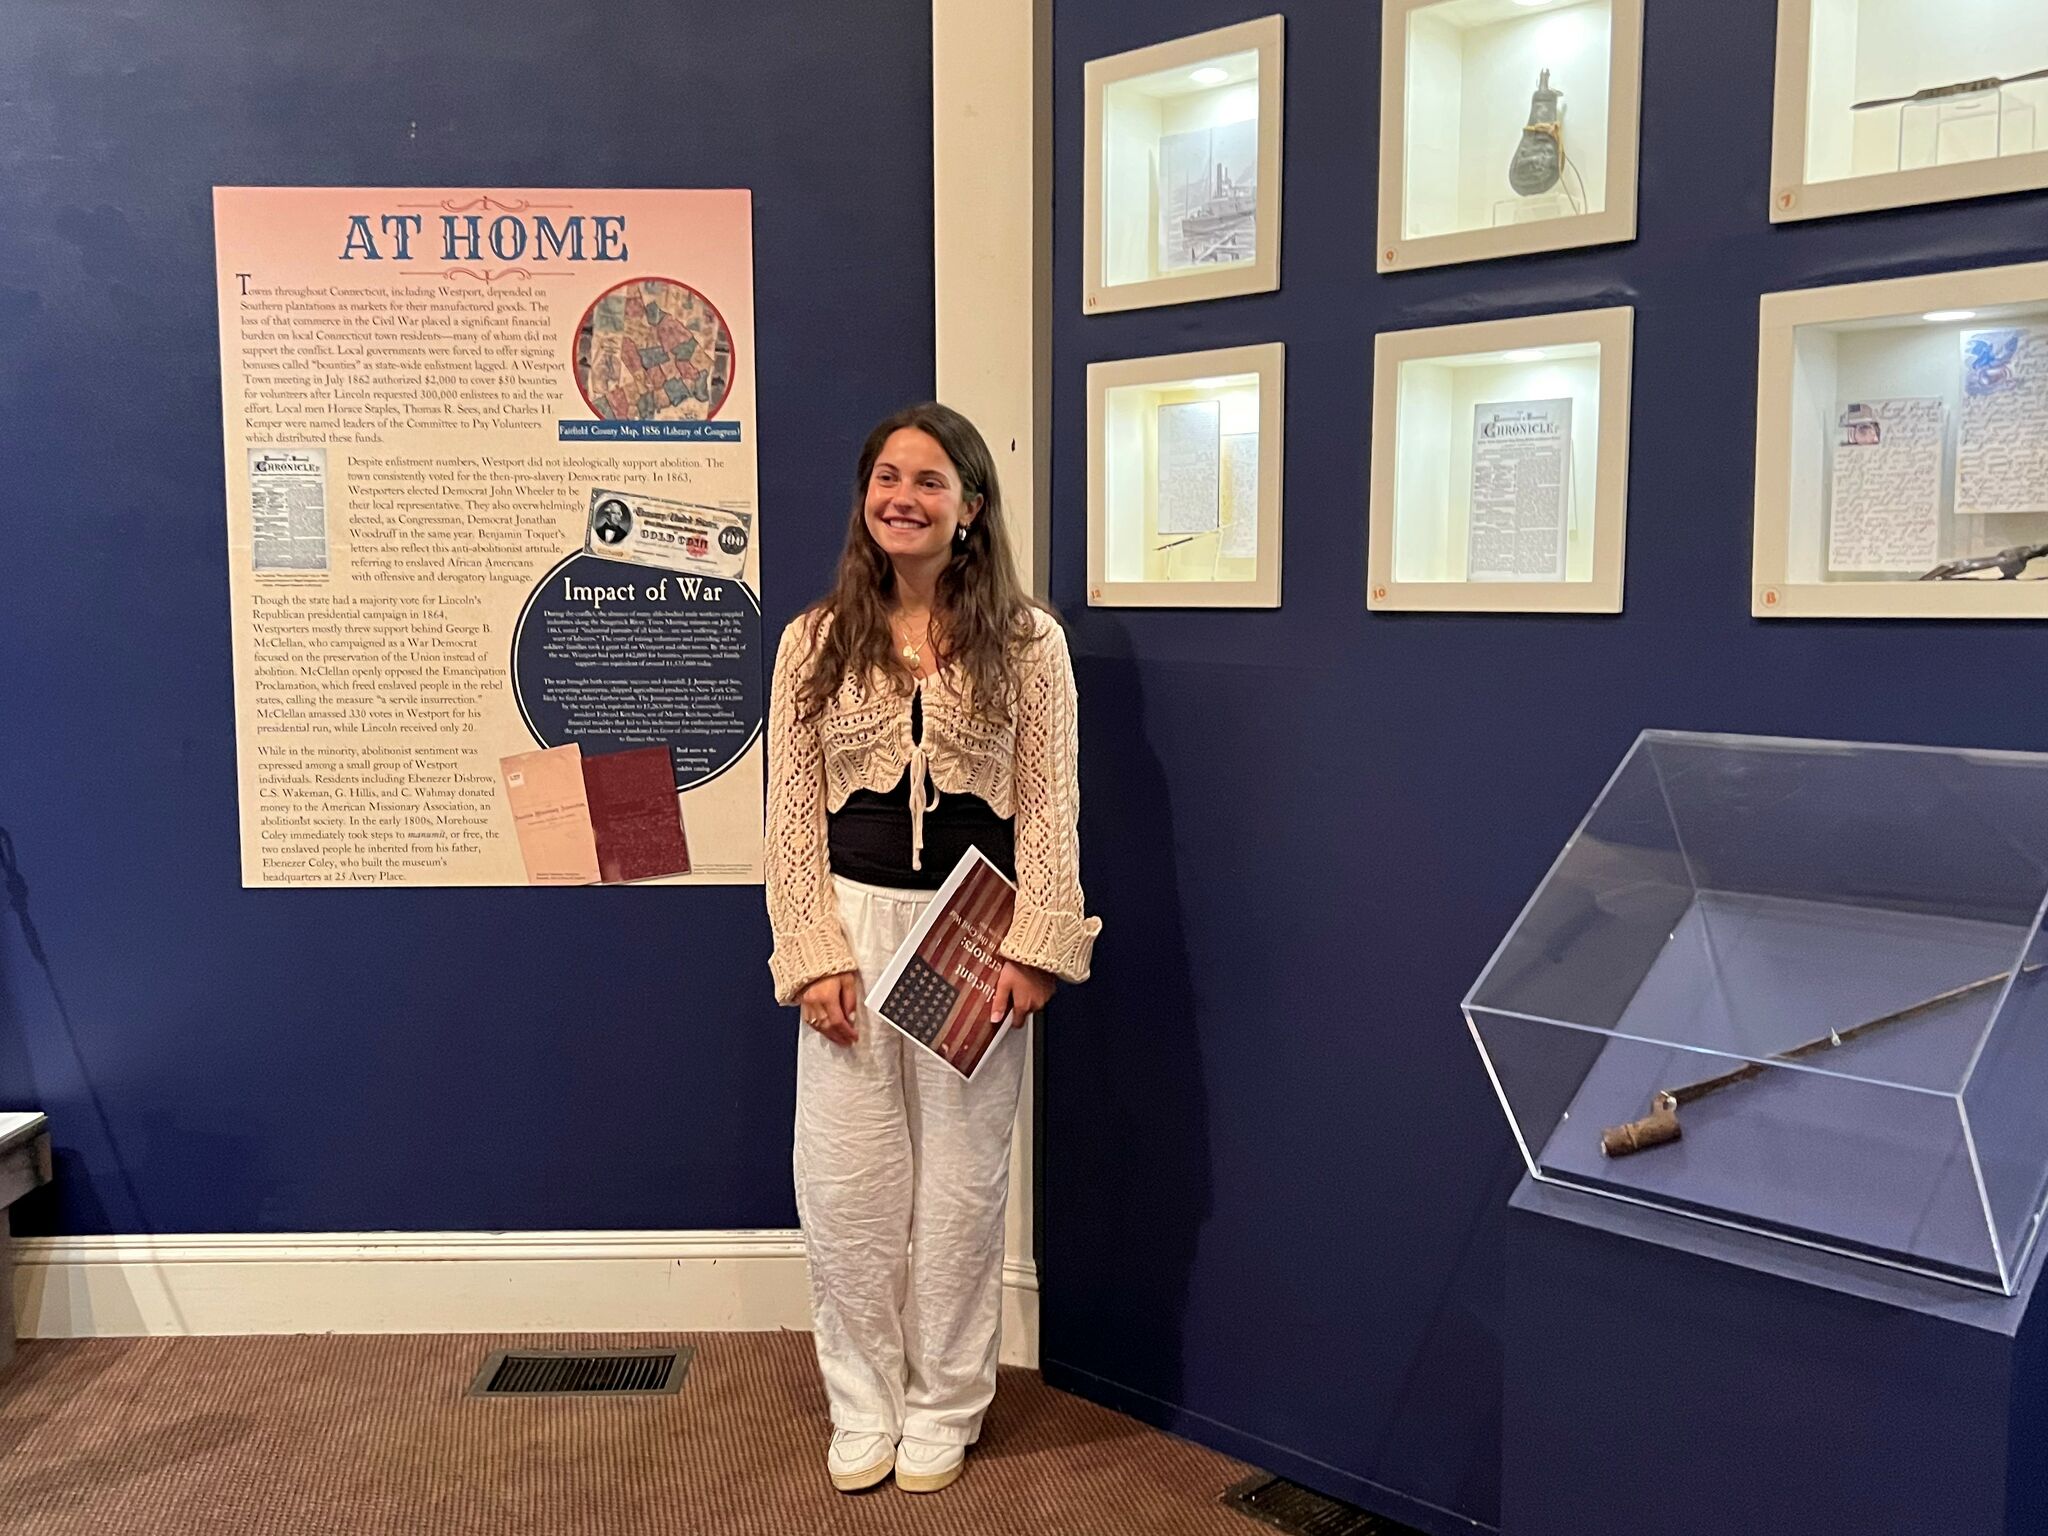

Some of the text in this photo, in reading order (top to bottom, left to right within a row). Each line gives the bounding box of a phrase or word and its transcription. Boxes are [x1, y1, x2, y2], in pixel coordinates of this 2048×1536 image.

[338, 214, 629, 262] AT HOME
[236, 273, 272, 296] Towns
[275, 287, 327, 299] throughout
[330, 287, 388, 298] Connecticut,
[392, 287, 435, 299] including
[438, 287, 484, 299] Westport,
[487, 287, 532, 299] depended
[240, 302, 282, 311] Southern
[286, 302, 335, 313] plantations
[350, 302, 387, 311] markets
[390, 302, 402, 311] for
[406, 302, 426, 311] their
[430, 302, 494, 311] manufactured
[530, 302, 548, 311] The
[241, 316, 258, 326] loss
[261, 316, 270, 326] of
[273, 316, 290, 326] that
[343, 317, 352, 326] in
[355, 316, 369, 326] the
[372, 316, 395, 326] Civil
[398, 316, 418, 326] War
[421, 316, 451, 328] placed
[461, 316, 508, 328] significant
[512, 316, 550, 326] financial
[246, 375, 271, 385] Town
[274, 376, 311, 387] meeting
[314, 376, 322, 385] in
[325, 375, 343, 387] July
[348, 375, 370, 385] 1862
[373, 375, 422, 385] authorized
[425, 375, 456, 387] $2,000
[459, 376, 468, 385] to
[518, 375, 556, 385] bounties
[244, 390, 257, 399] for
[260, 390, 308, 399] volunteers
[310, 390, 330, 399] after
[334, 390, 370, 399] Lincoln
[374, 390, 417, 401] requested
[421, 390, 458, 401] 300,000
[501, 391, 510, 399] to
[513, 390, 527, 399] aid
[530, 390, 543, 399] the
[560, 425, 588, 435] Fairfield
[590, 425, 618, 437] County
[694, 426, 702, 435] of
[246, 433, 273, 443] which
[276, 433, 326, 443] distributed
[329, 433, 352, 443] these
[348, 457, 383, 469] Despite
[385, 457, 432, 467] enlistment
[436, 457, 479, 468] numbers,
[482, 457, 524, 469] Westport
[528, 457, 543, 467] did
[546, 458, 560, 467] not
[563, 457, 620, 469] ideologically
[623, 458, 657, 469] support
[705, 457, 724, 467] The
[348, 472, 370, 481] town
[373, 472, 425, 483] consistently
[429, 472, 454, 481] voted
[457, 472, 470, 481] for
[473, 472, 486, 481] the
[568, 472, 620, 481] Democratic
[653, 472, 663, 481] In
[667, 472, 691, 482] 1863,
[398, 515, 464, 526] Congressman,
[467, 515, 512, 524] Democrat
[515, 515, 556, 526] Jonathan
[564, 576, 725, 607] Impact of War
[1374, 588, 1386, 600] 10
[252, 595, 289, 607] Though
[292, 595, 306, 605] the
[309, 596, 330, 605] state
[332, 595, 350, 605] had
[360, 596, 398, 607] majority
[401, 596, 419, 605] vote
[422, 595, 435, 605] for
[438, 595, 481, 605] Lincoln's
[253, 610, 447, 621] Republican presidential campaign in 1864,
[257, 709, 306, 718] McClellan
[308, 709, 346, 718] amassed
[370, 710, 392, 718] votes
[395, 710, 404, 718] in
[407, 709, 450, 720] Westport
[452, 709, 465, 718] for
[468, 709, 481, 718] his
[315, 774, 359, 783] Residents
[362, 774, 405, 786] including
[408, 774, 451, 783] Ebenezer
[454, 774, 495, 785] Disbrow,
[282, 788, 332, 799] Wakeman,
[381, 788, 398, 797] and
[458, 788, 495, 797] donated
[263, 872, 321, 883] headquarters
[324, 872, 332, 881] at
[350, 872, 376, 883] Avery
[961, 937, 1002, 972] erators:
[955, 964, 996, 1002] luctant
